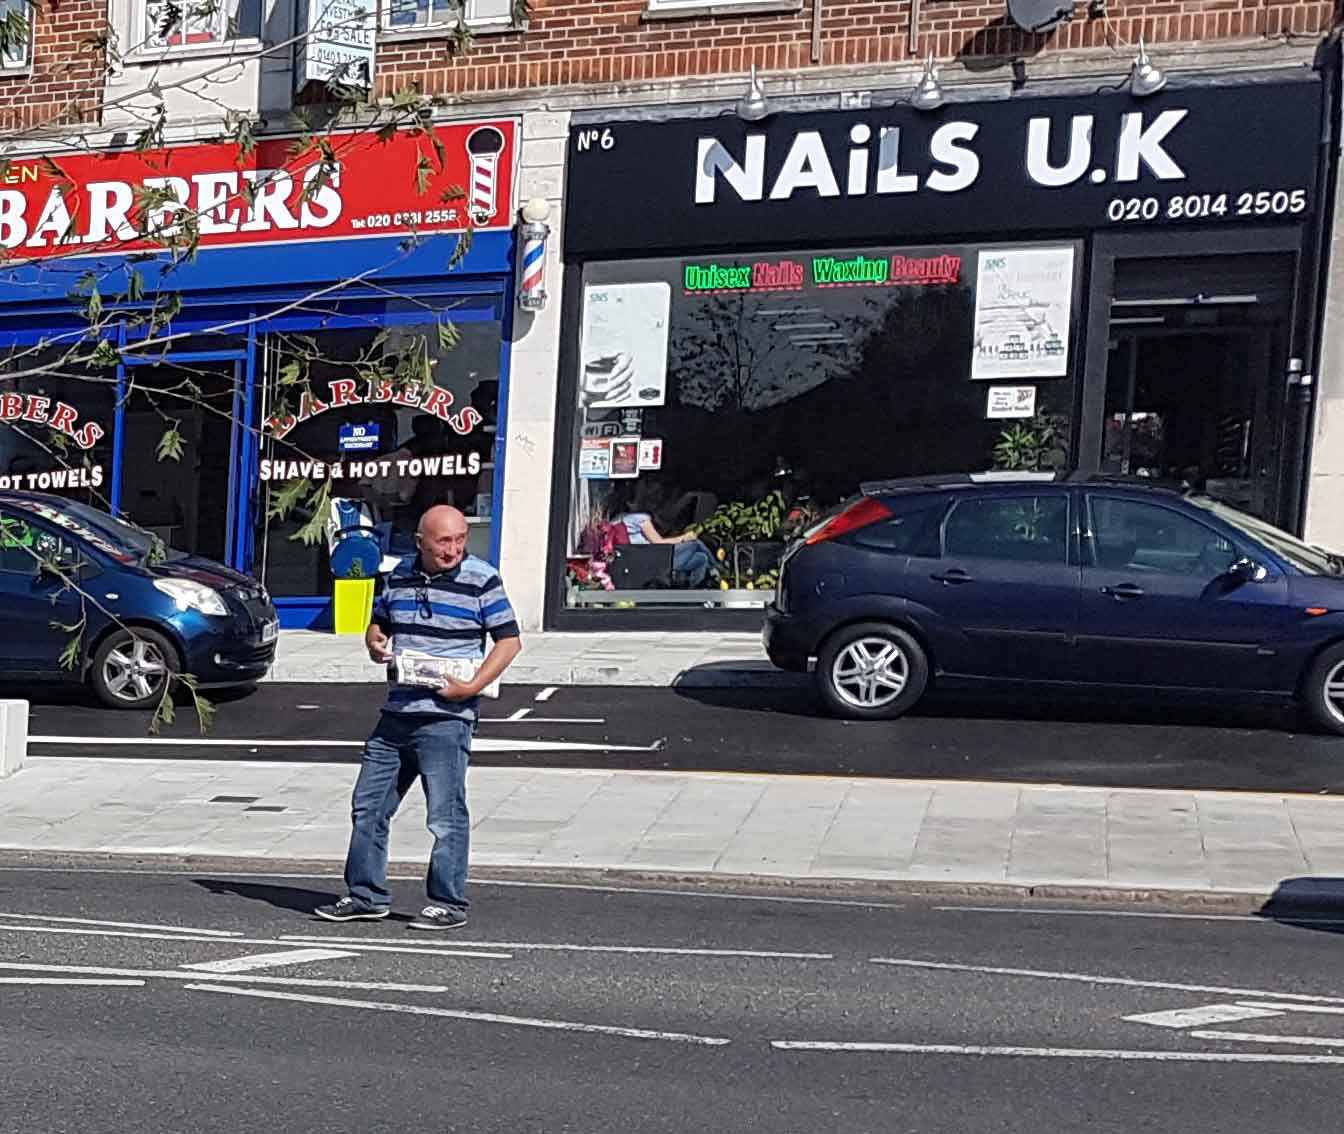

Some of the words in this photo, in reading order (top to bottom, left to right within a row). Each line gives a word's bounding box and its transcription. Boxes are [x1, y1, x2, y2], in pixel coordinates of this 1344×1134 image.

[343, 29, 371, 45] SALE
[1026, 109, 1189, 187] U.K
[1108, 198, 1159, 221] 020
[1167, 194, 1227, 218] 8014
[1237, 189, 1306, 214] 2505
[367, 215, 391, 228] 020
[685, 264, 751, 289] Unisex
[752, 260, 804, 285] Nails
[813, 255, 889, 284] Waxing
[890, 254, 960, 282] Beauty
[264, 378, 483, 440] BARBERS
[353, 427, 366, 437] NO
[27, 465, 103, 489] TOWELS
[260, 459, 324, 480] SHAVE
[331, 462, 344, 478] &
[349, 460, 392, 478] HOT
[397, 451, 481, 476] TOWELS
